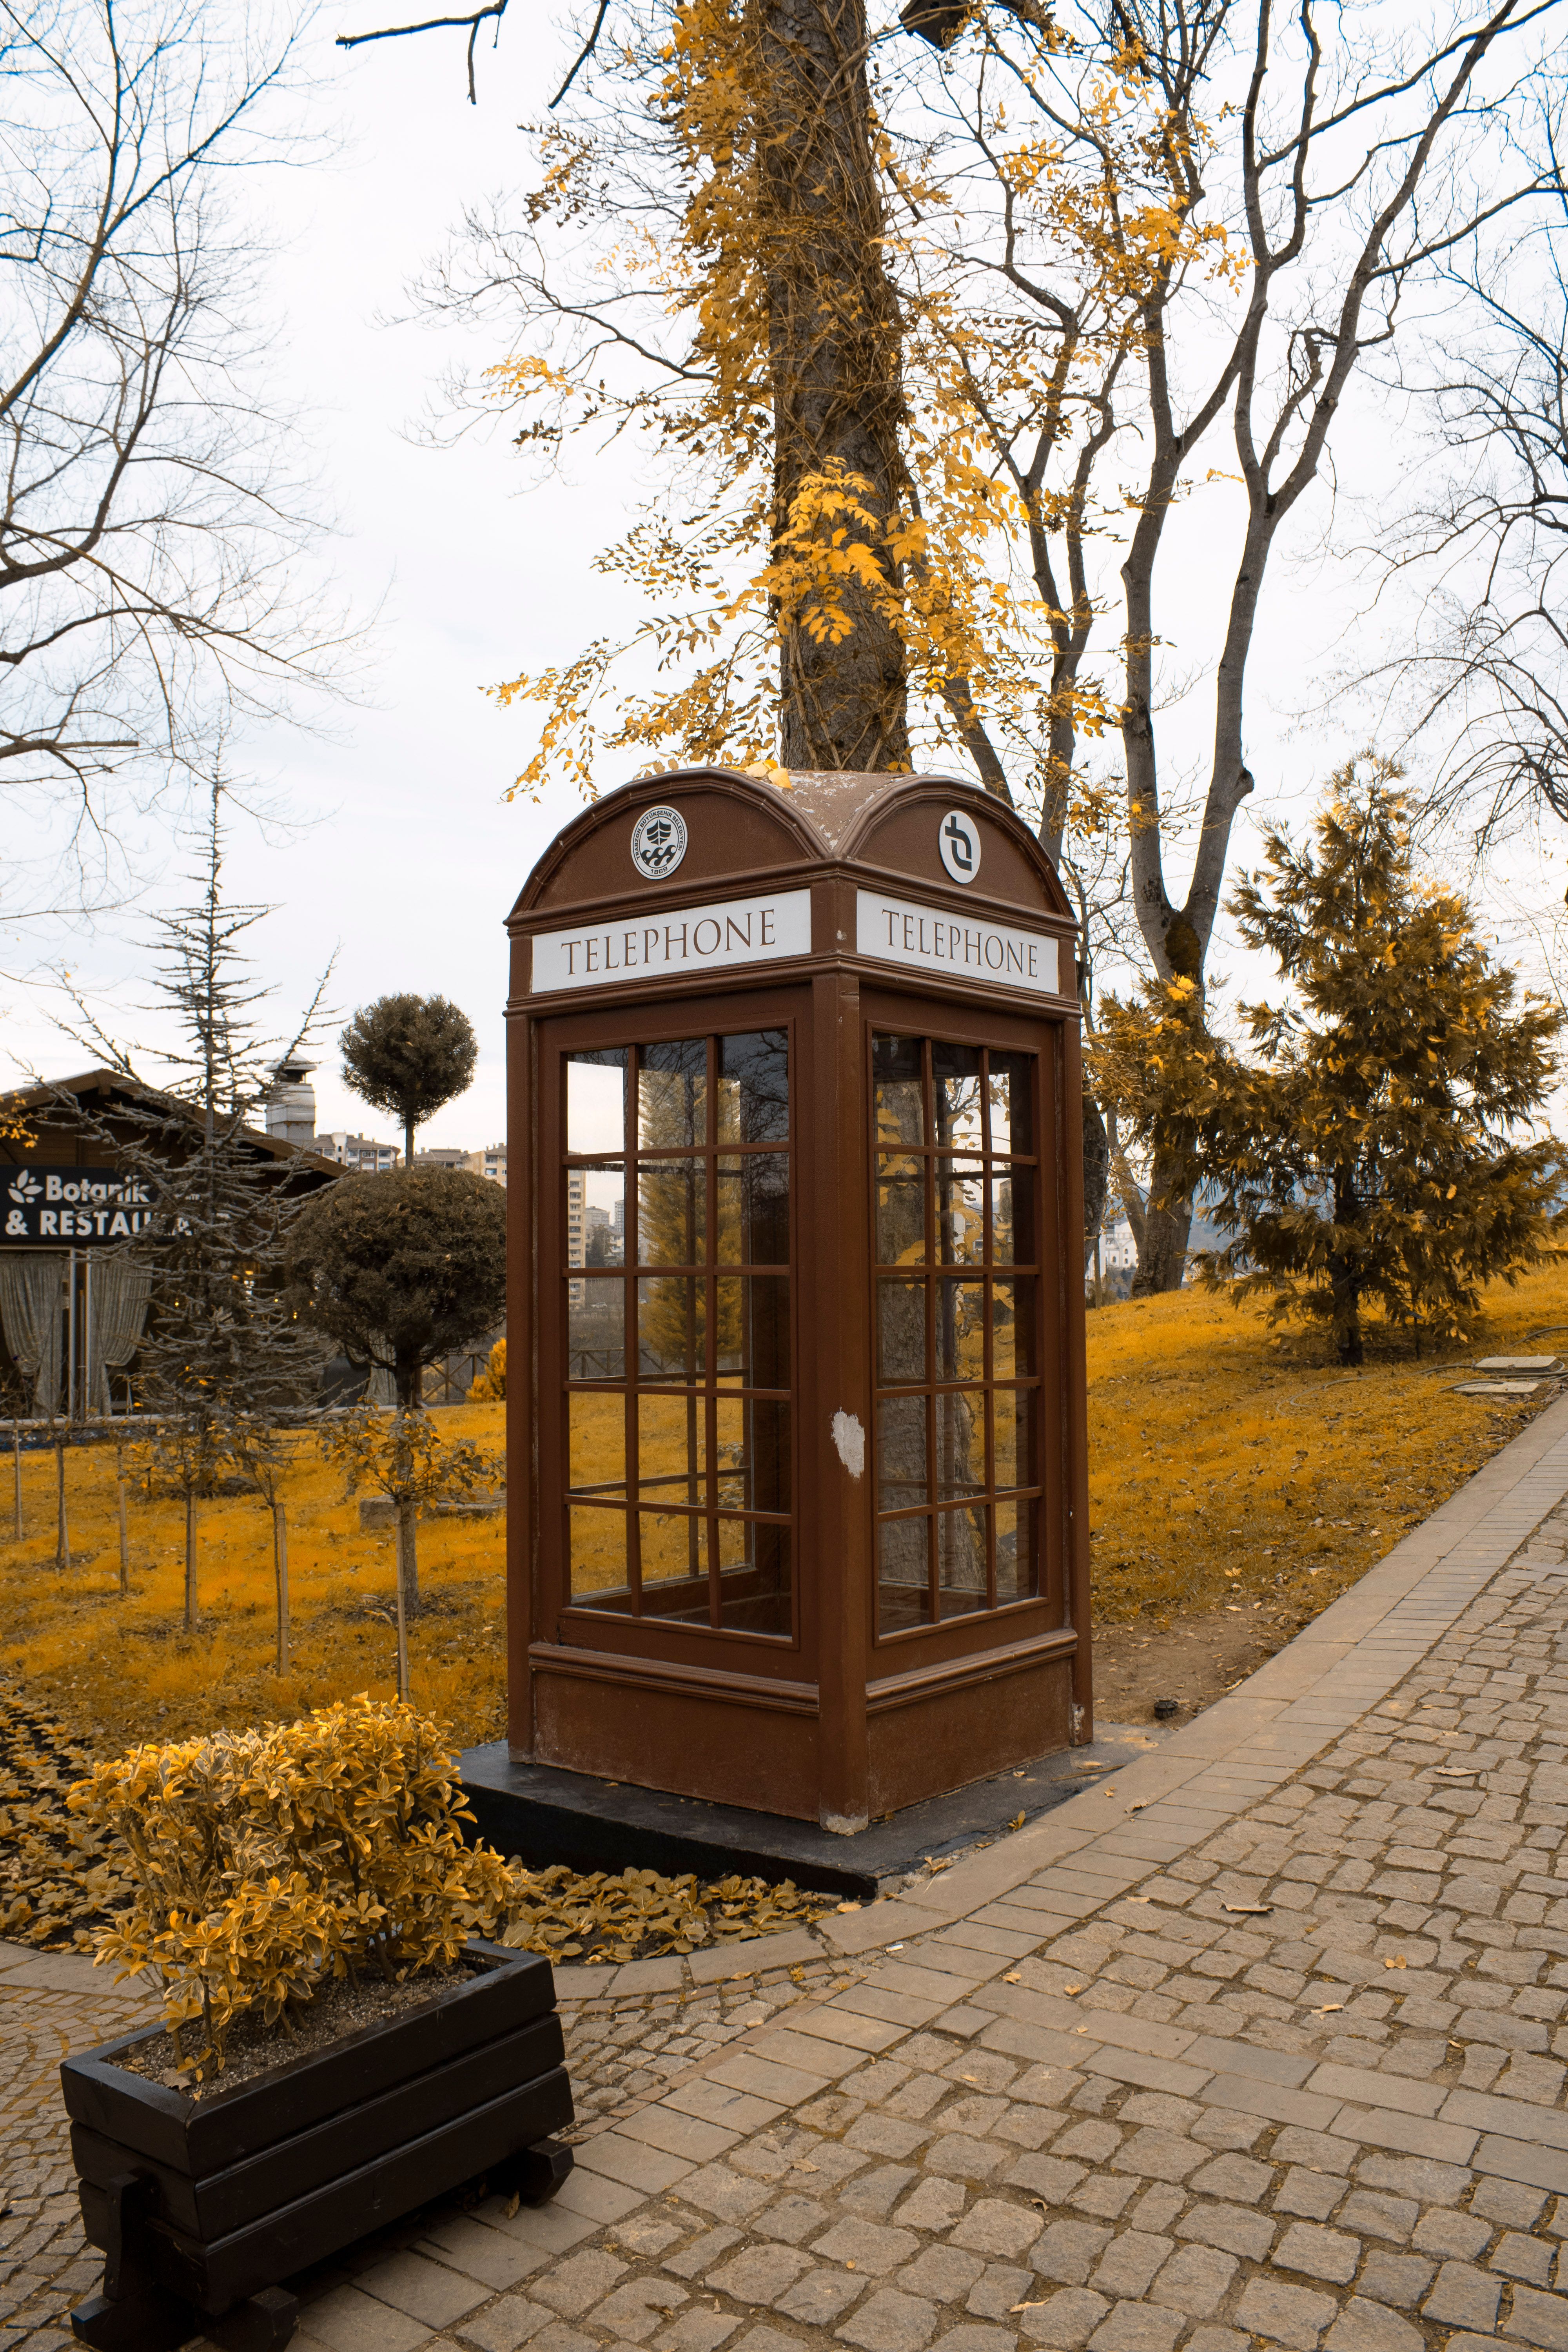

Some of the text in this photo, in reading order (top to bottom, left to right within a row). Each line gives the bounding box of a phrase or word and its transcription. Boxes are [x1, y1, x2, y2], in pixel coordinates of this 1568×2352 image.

[650, 866, 668, 875] 1868
[561, 909, 776, 975] TELEPHONE
[882, 909, 1038, 978] TELEPHONE
[45, 1175, 150, 1202] Botanik
[5, 1209, 30, 1236] &
